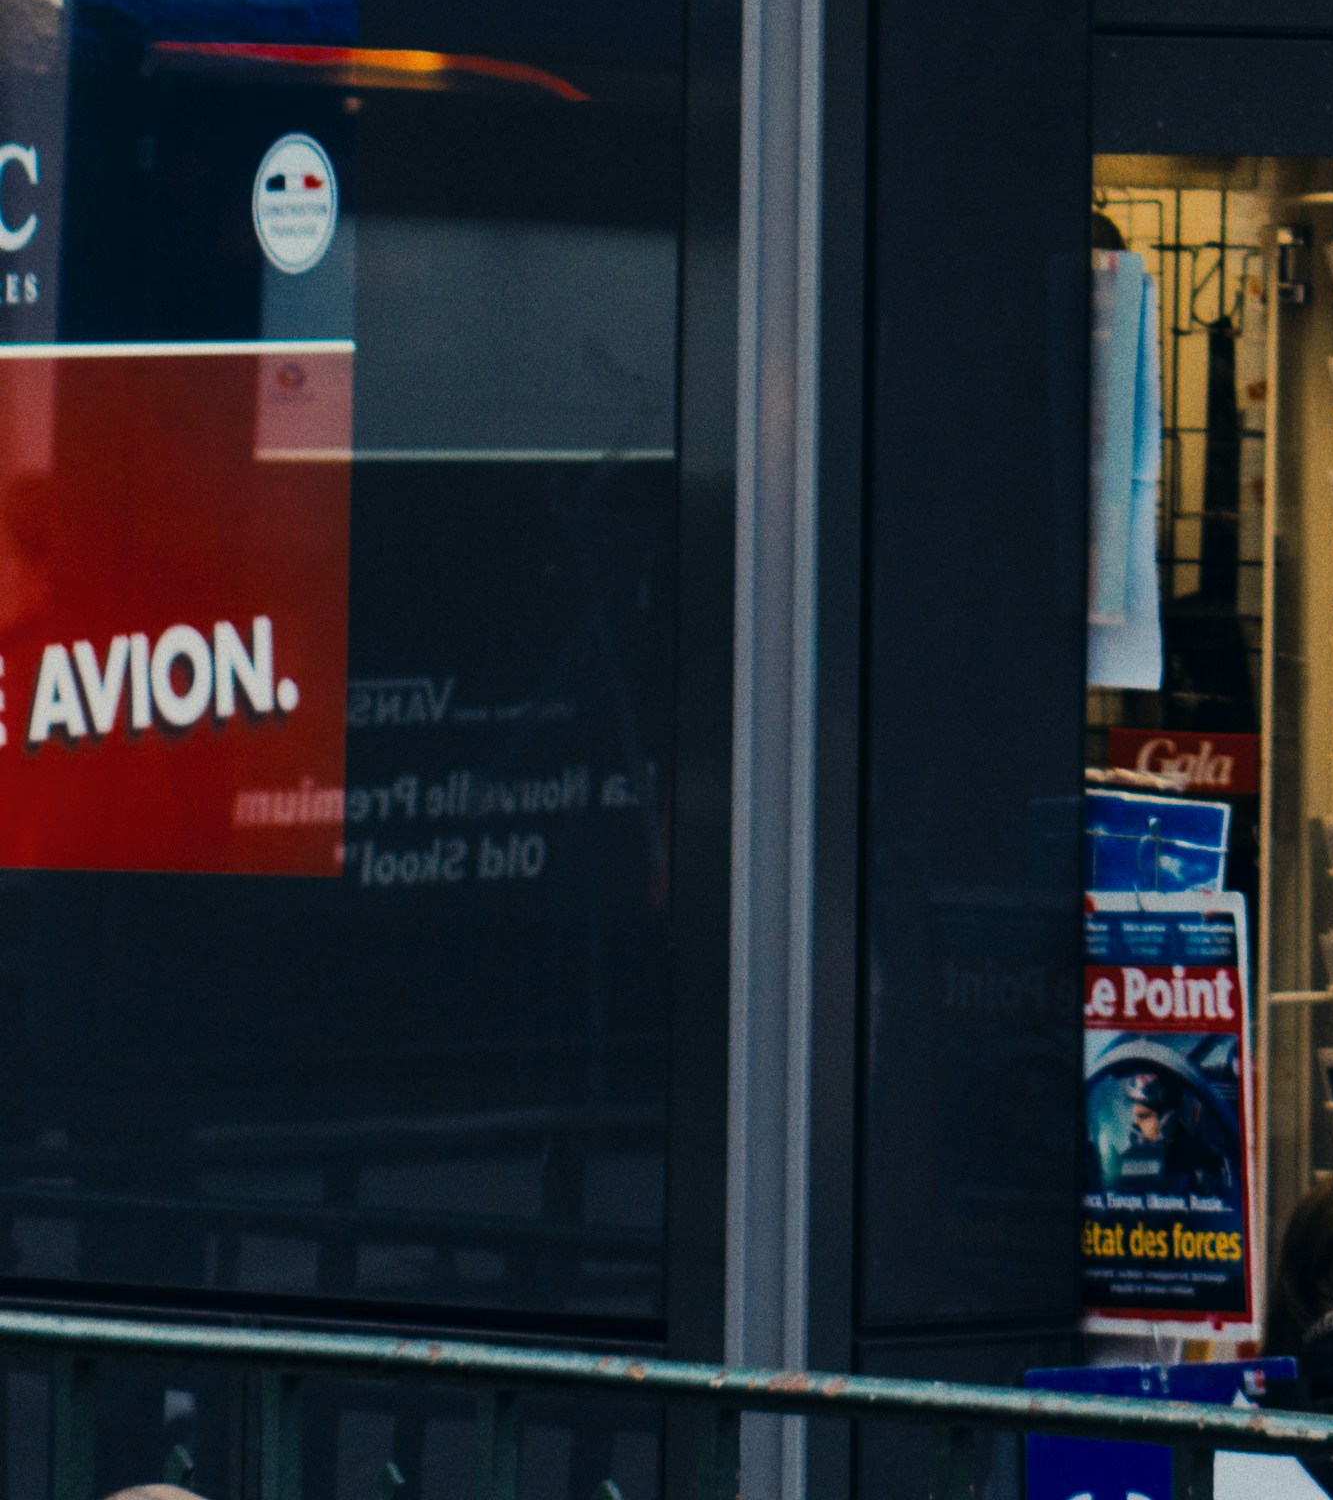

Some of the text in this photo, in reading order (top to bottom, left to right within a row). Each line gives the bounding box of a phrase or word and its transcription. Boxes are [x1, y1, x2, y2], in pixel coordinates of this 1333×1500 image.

[27, 615, 298, 742] AVION.
[1136, 737, 1235, 790] Gala
[1121, 965, 1235, 1020] Point
[1128, 1221, 1169, 1259] des
[1172, 1222, 1243, 1262] forces
